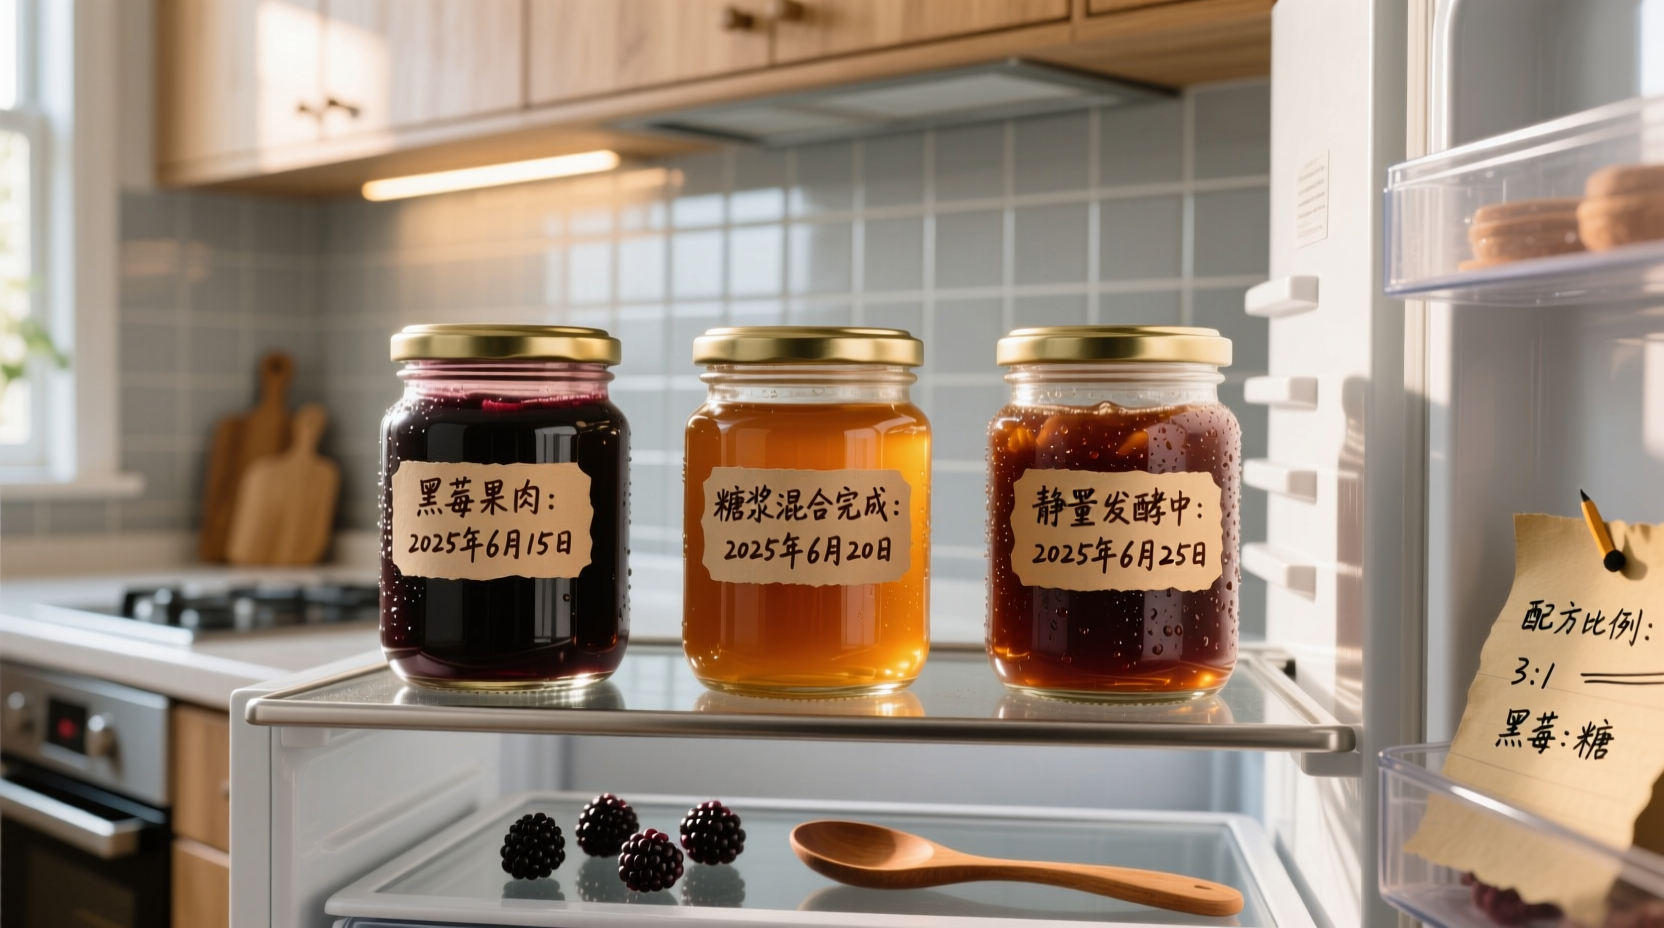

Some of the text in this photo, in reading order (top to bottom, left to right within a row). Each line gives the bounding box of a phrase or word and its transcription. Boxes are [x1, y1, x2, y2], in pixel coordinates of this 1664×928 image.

[416, 476, 555, 519] 黑莓果肉：
[408, 526, 572, 563] 2025年6月15日
[724, 532, 892, 569] 2025年6月20日
[1032, 537, 1206, 574] 2025年6月25日
[1521, 600, 1653, 646] 配方比例：
[1511, 657, 1555, 689] 3:1
